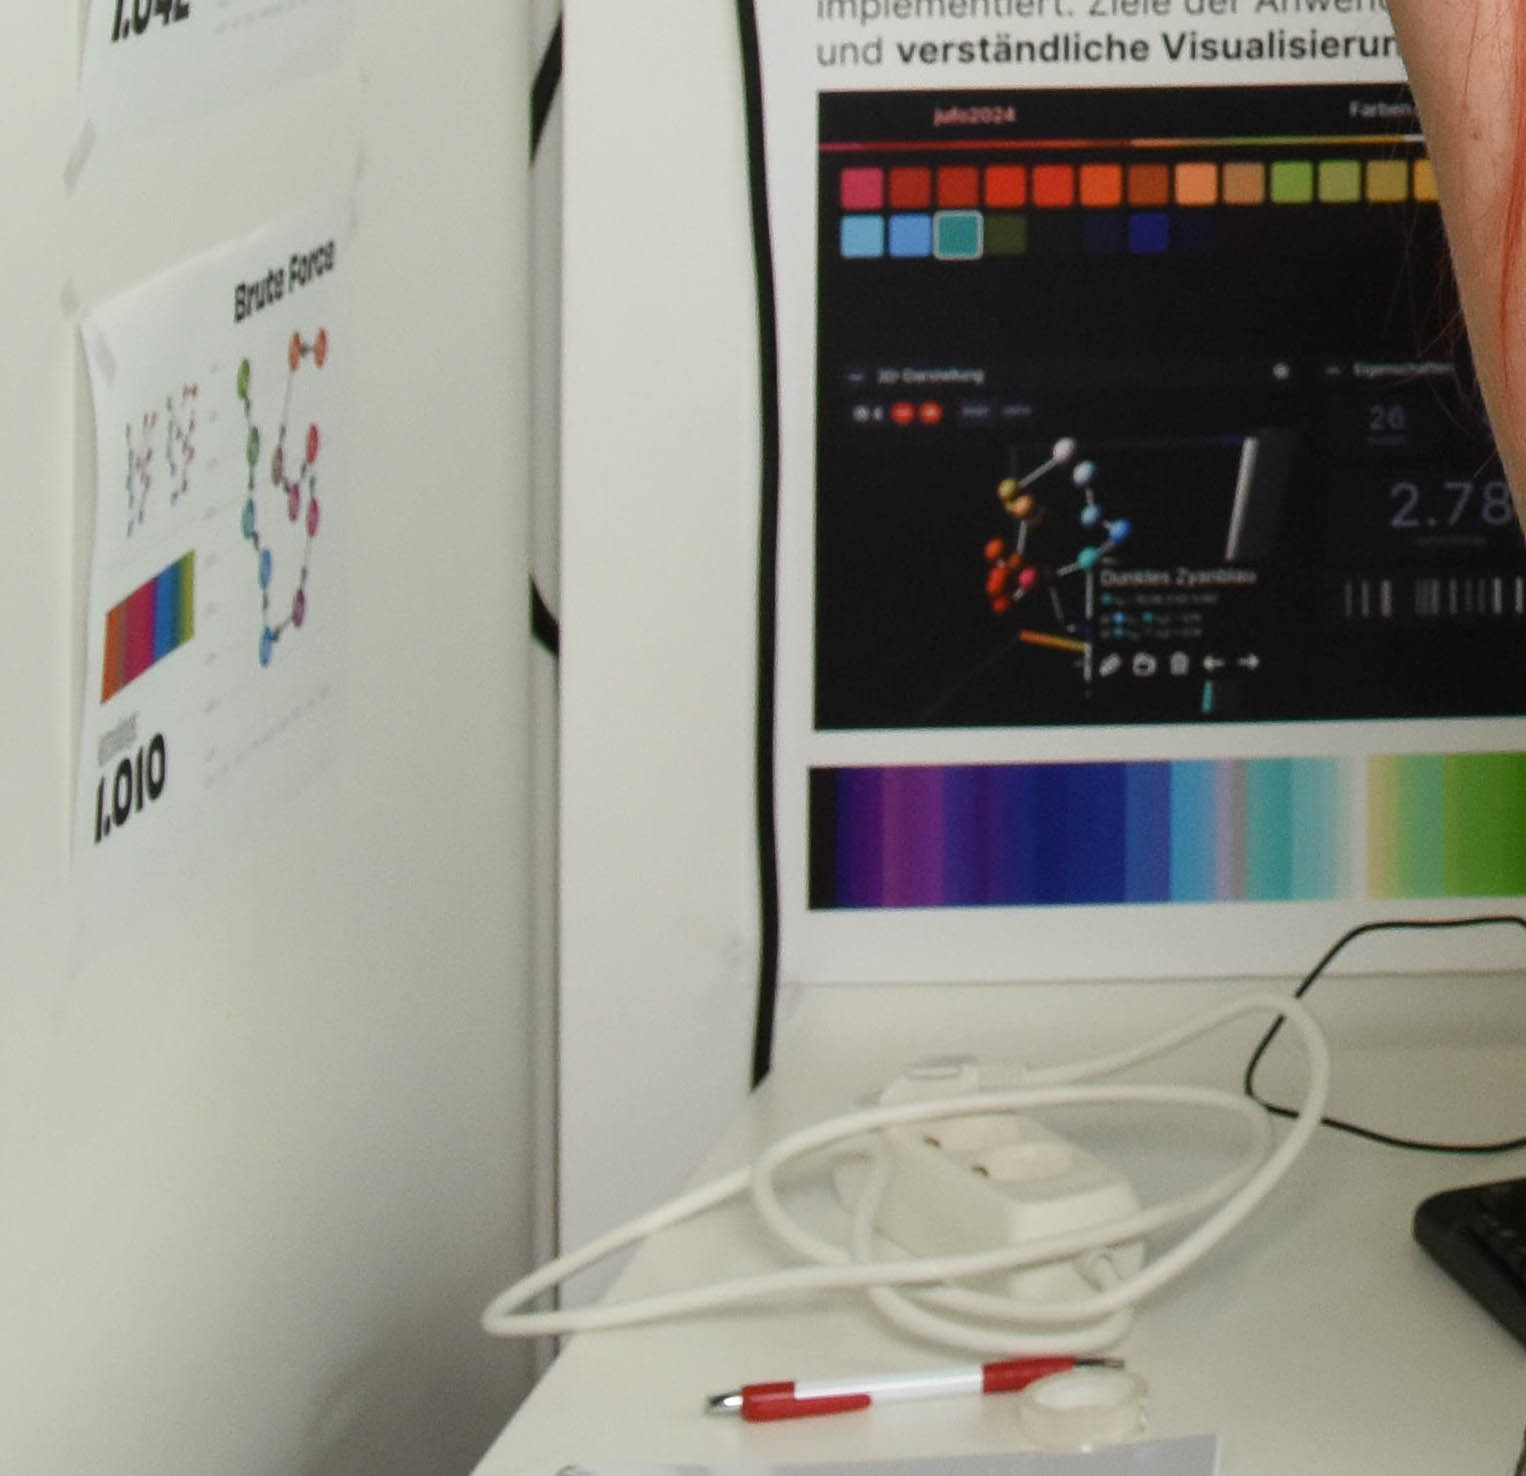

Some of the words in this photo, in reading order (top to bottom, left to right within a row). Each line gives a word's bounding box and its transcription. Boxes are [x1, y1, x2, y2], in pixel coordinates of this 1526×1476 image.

[818, 37, 882, 65] und
[897, 32, 1150, 65] verständliche
[233, 269, 285, 324] Brute
[288, 239, 337, 294] Force
